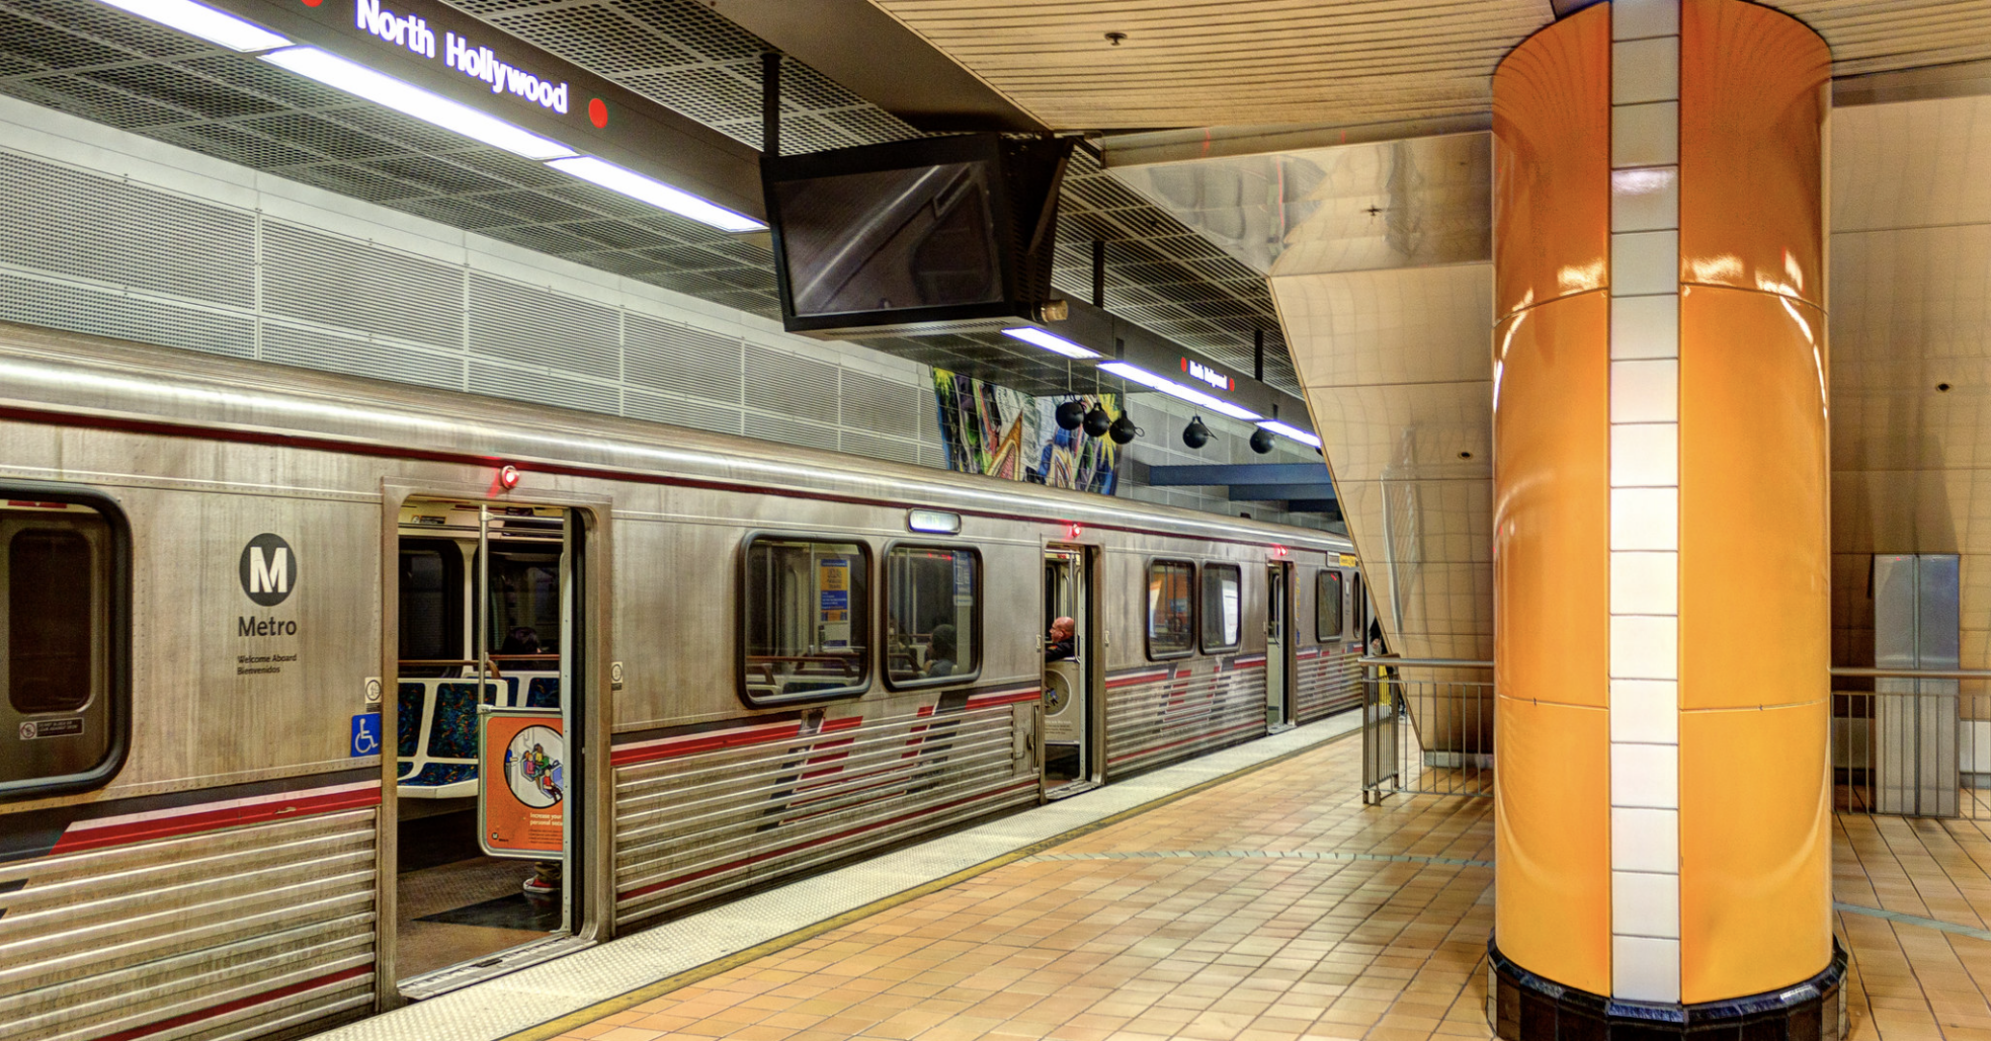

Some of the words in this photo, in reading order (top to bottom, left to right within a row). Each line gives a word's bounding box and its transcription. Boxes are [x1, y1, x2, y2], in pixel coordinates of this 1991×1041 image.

[356, 0, 436, 59] North
[445, 31, 569, 115] Hollywood
[250, 546, 288, 593] M
[238, 615, 297, 637] Metro
[237, 655, 271, 664] Welcome
[272, 653, 297, 662] Aboard
[237, 665, 280, 675] Bienvenidos
